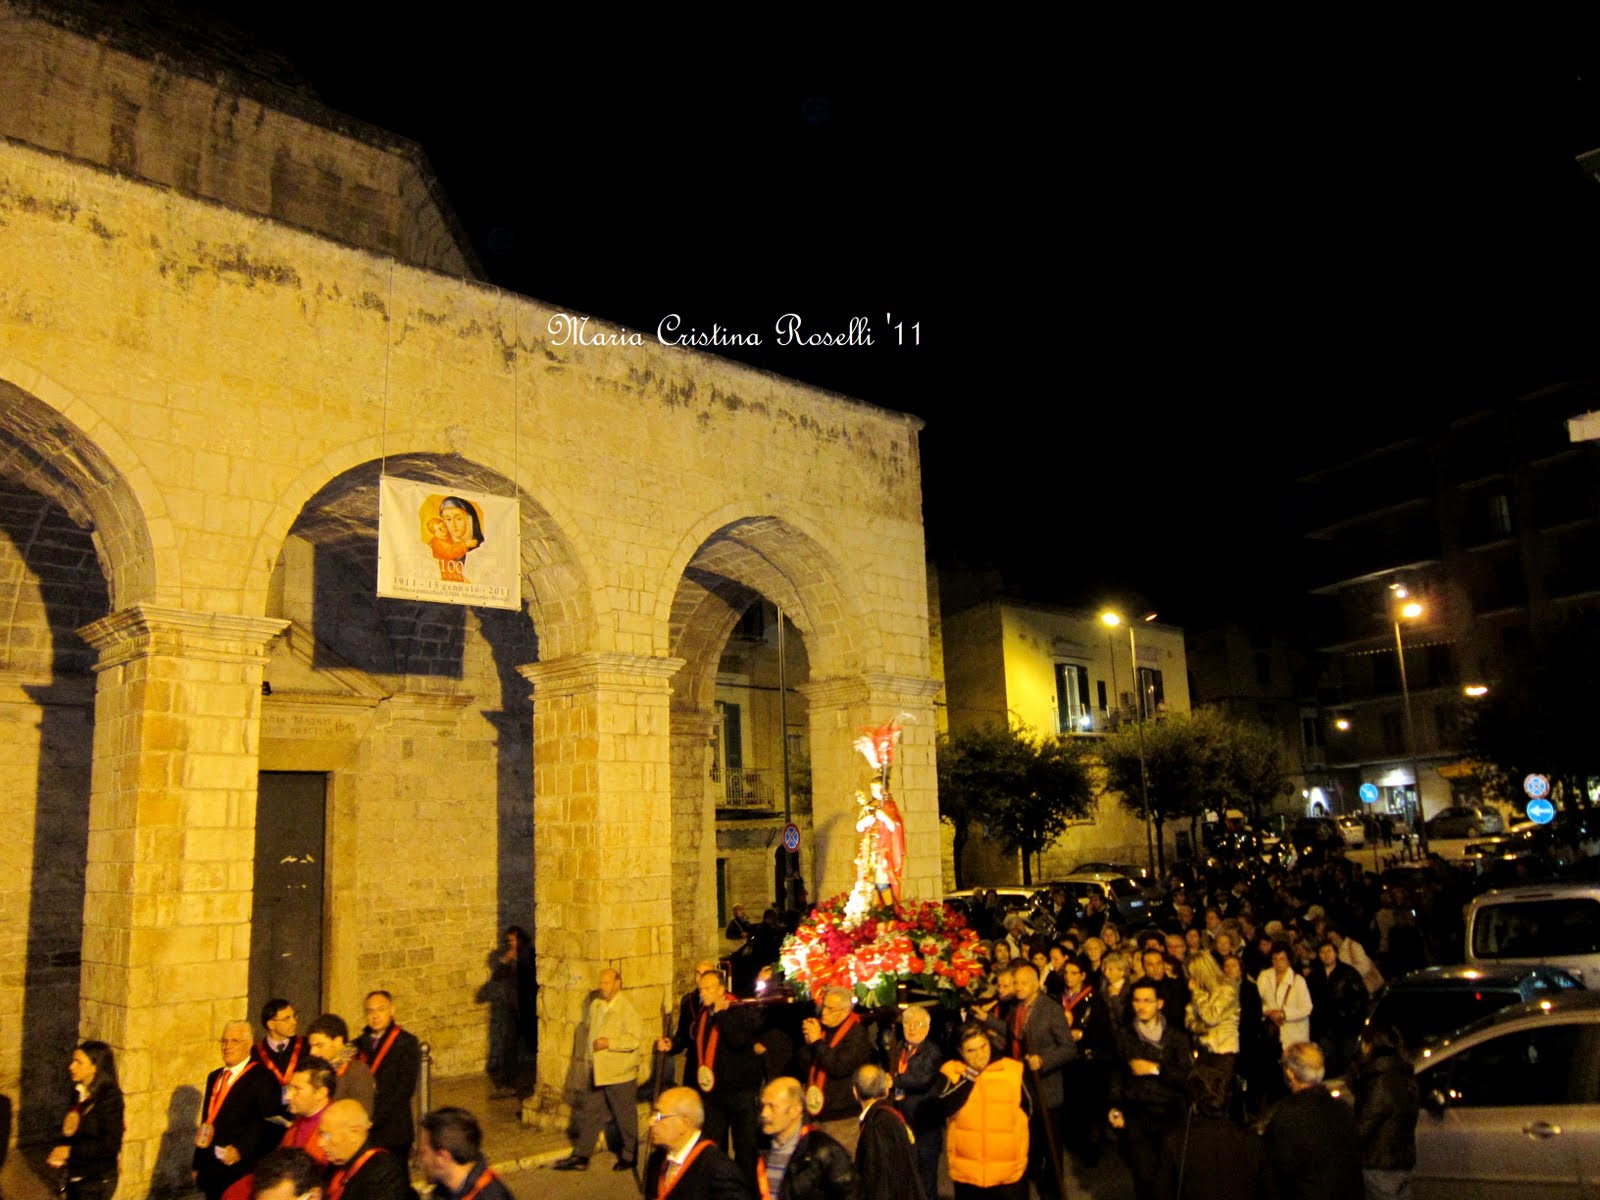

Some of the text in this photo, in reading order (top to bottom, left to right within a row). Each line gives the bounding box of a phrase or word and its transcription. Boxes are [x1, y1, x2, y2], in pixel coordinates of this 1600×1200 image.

[440, 559, 464, 574] 100
[393, 576, 416, 586] 1911
[428, 581, 440, 589] 15
[442, 584, 480, 593] gennaio
[488, 586, 510, 596] 2011
